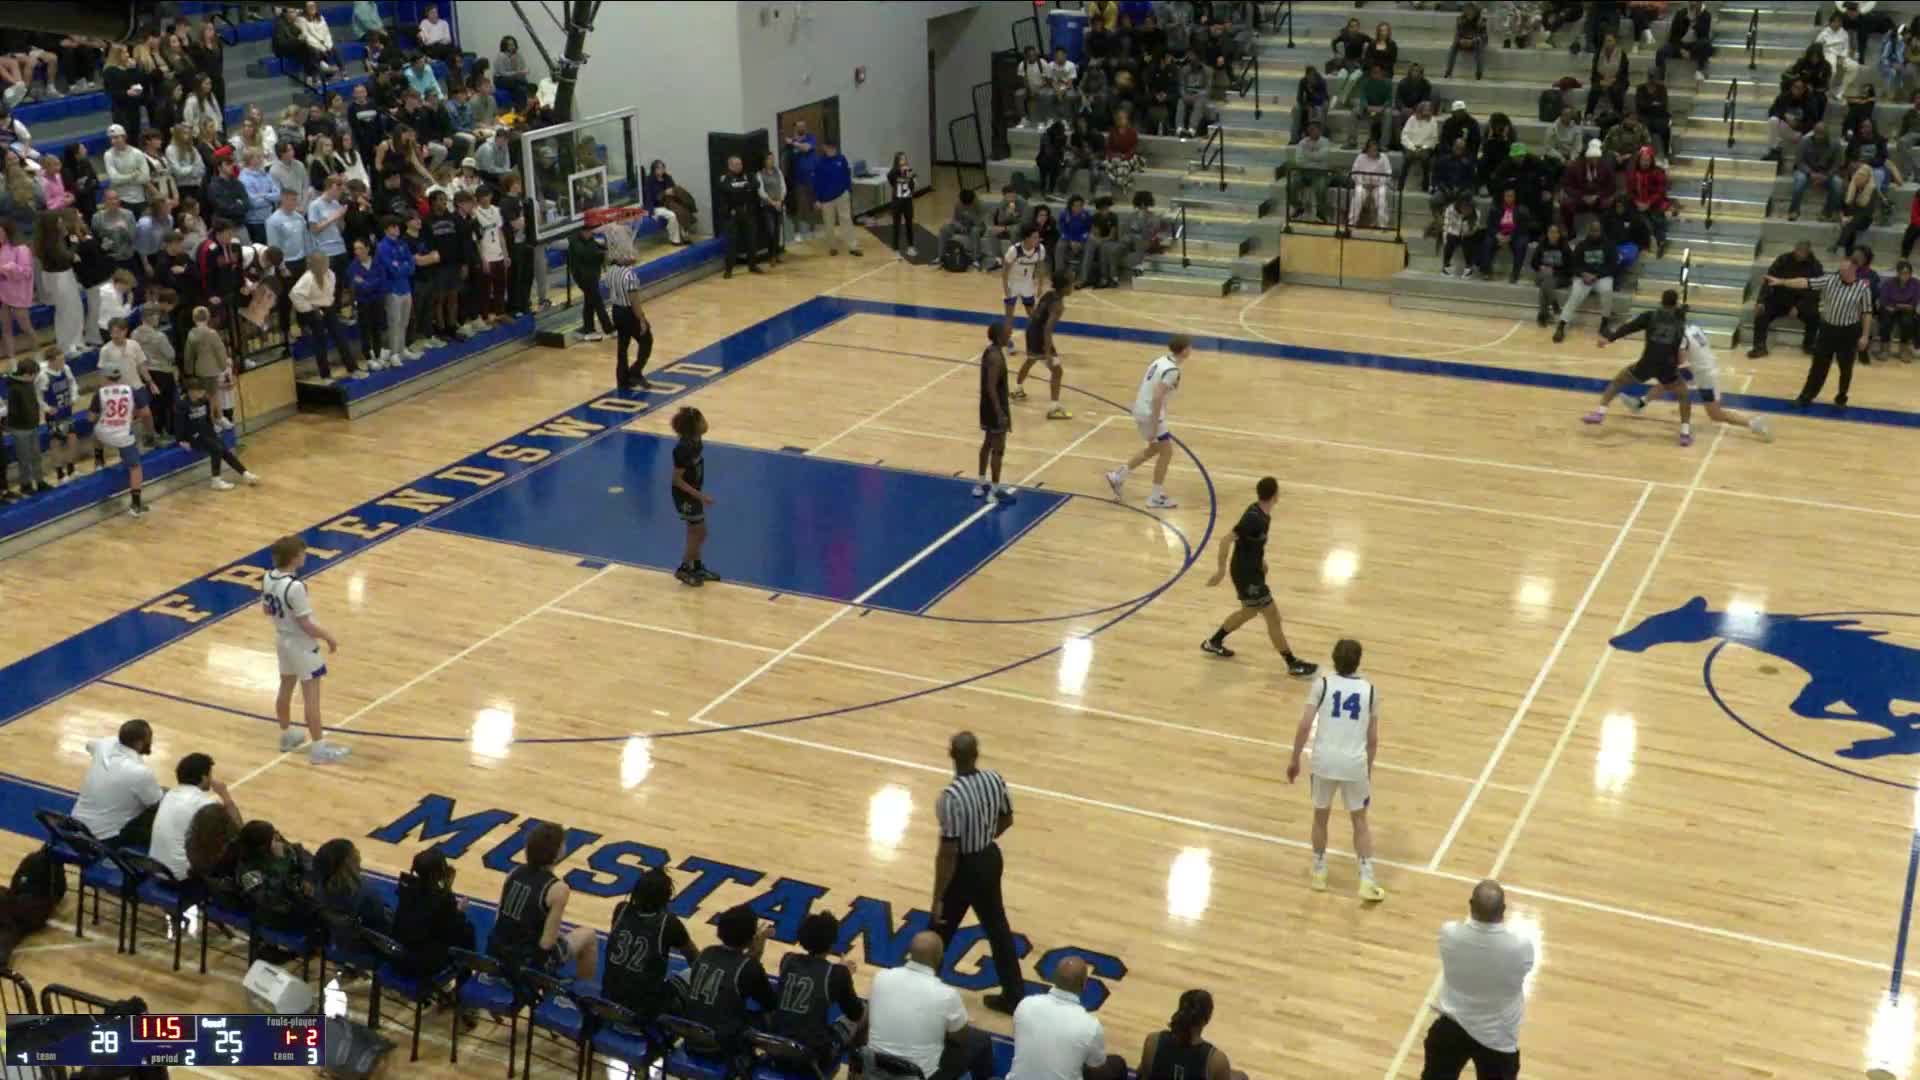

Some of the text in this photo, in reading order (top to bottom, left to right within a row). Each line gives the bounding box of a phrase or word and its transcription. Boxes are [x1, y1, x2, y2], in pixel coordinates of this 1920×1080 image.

[105, 397, 129, 420] 36
[139, 362, 723, 623] FRIENDSWOOD
[1330, 689, 1362, 721] 14
[367, 792, 1129, 1013] MUSTANGS
[501, 879, 532, 921] 11
[609, 929, 649, 973] 32
[689, 962, 726, 1006] 14
[779, 971, 815, 1015] 12
